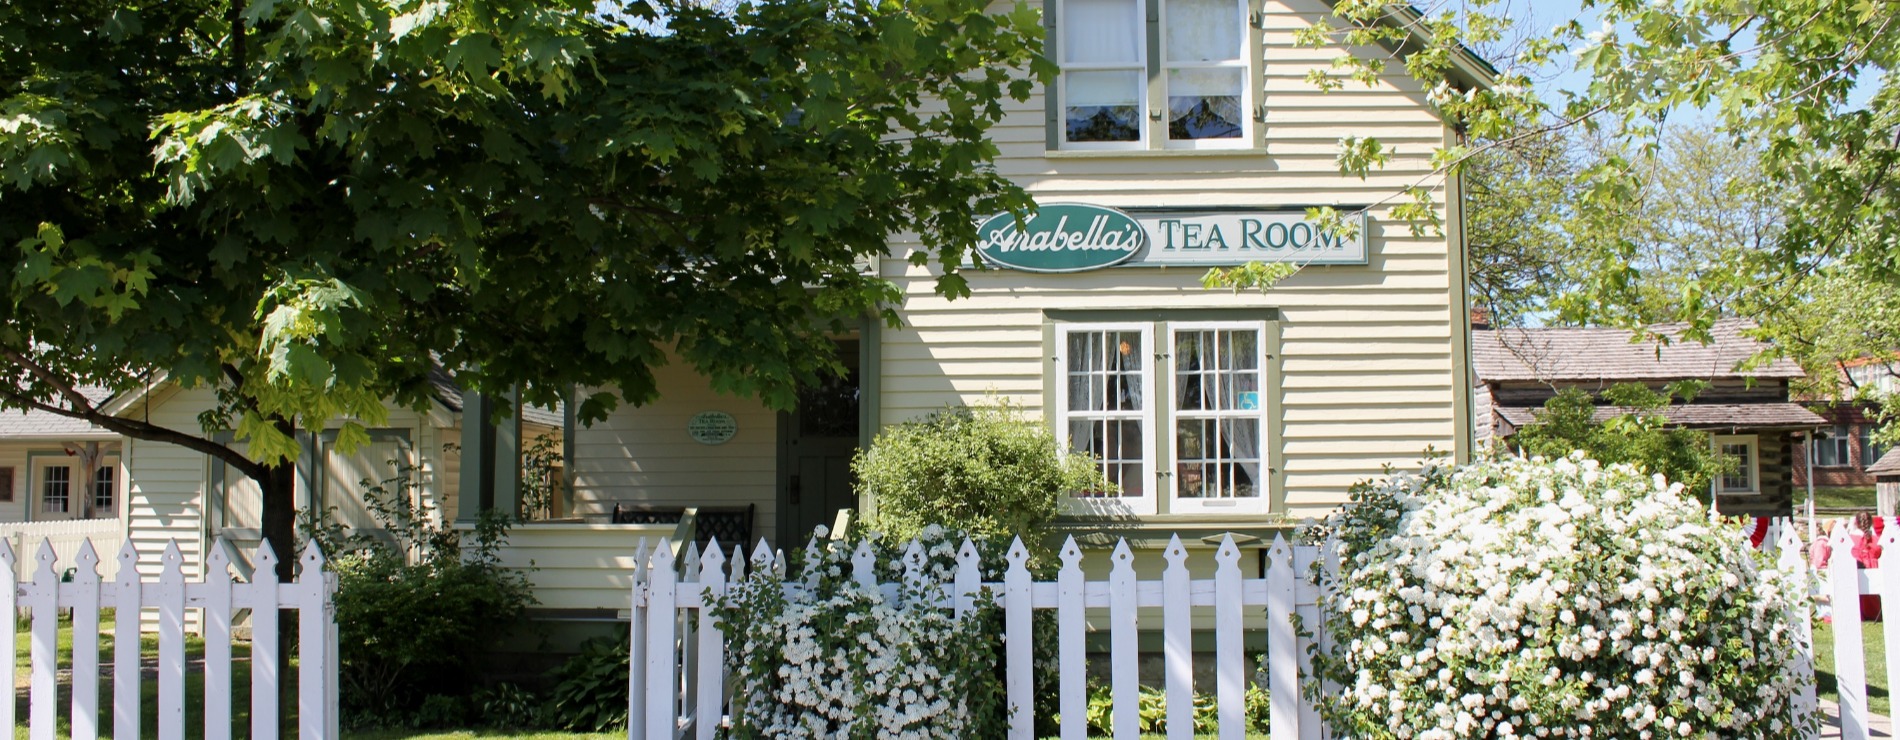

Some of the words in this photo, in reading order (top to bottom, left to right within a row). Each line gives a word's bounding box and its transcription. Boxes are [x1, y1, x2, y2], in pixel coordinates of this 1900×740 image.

[979, 213, 1138, 253] Arabella's
[1158, 218, 1229, 250] TEA
[1239, 218, 1344, 250] ROOM
